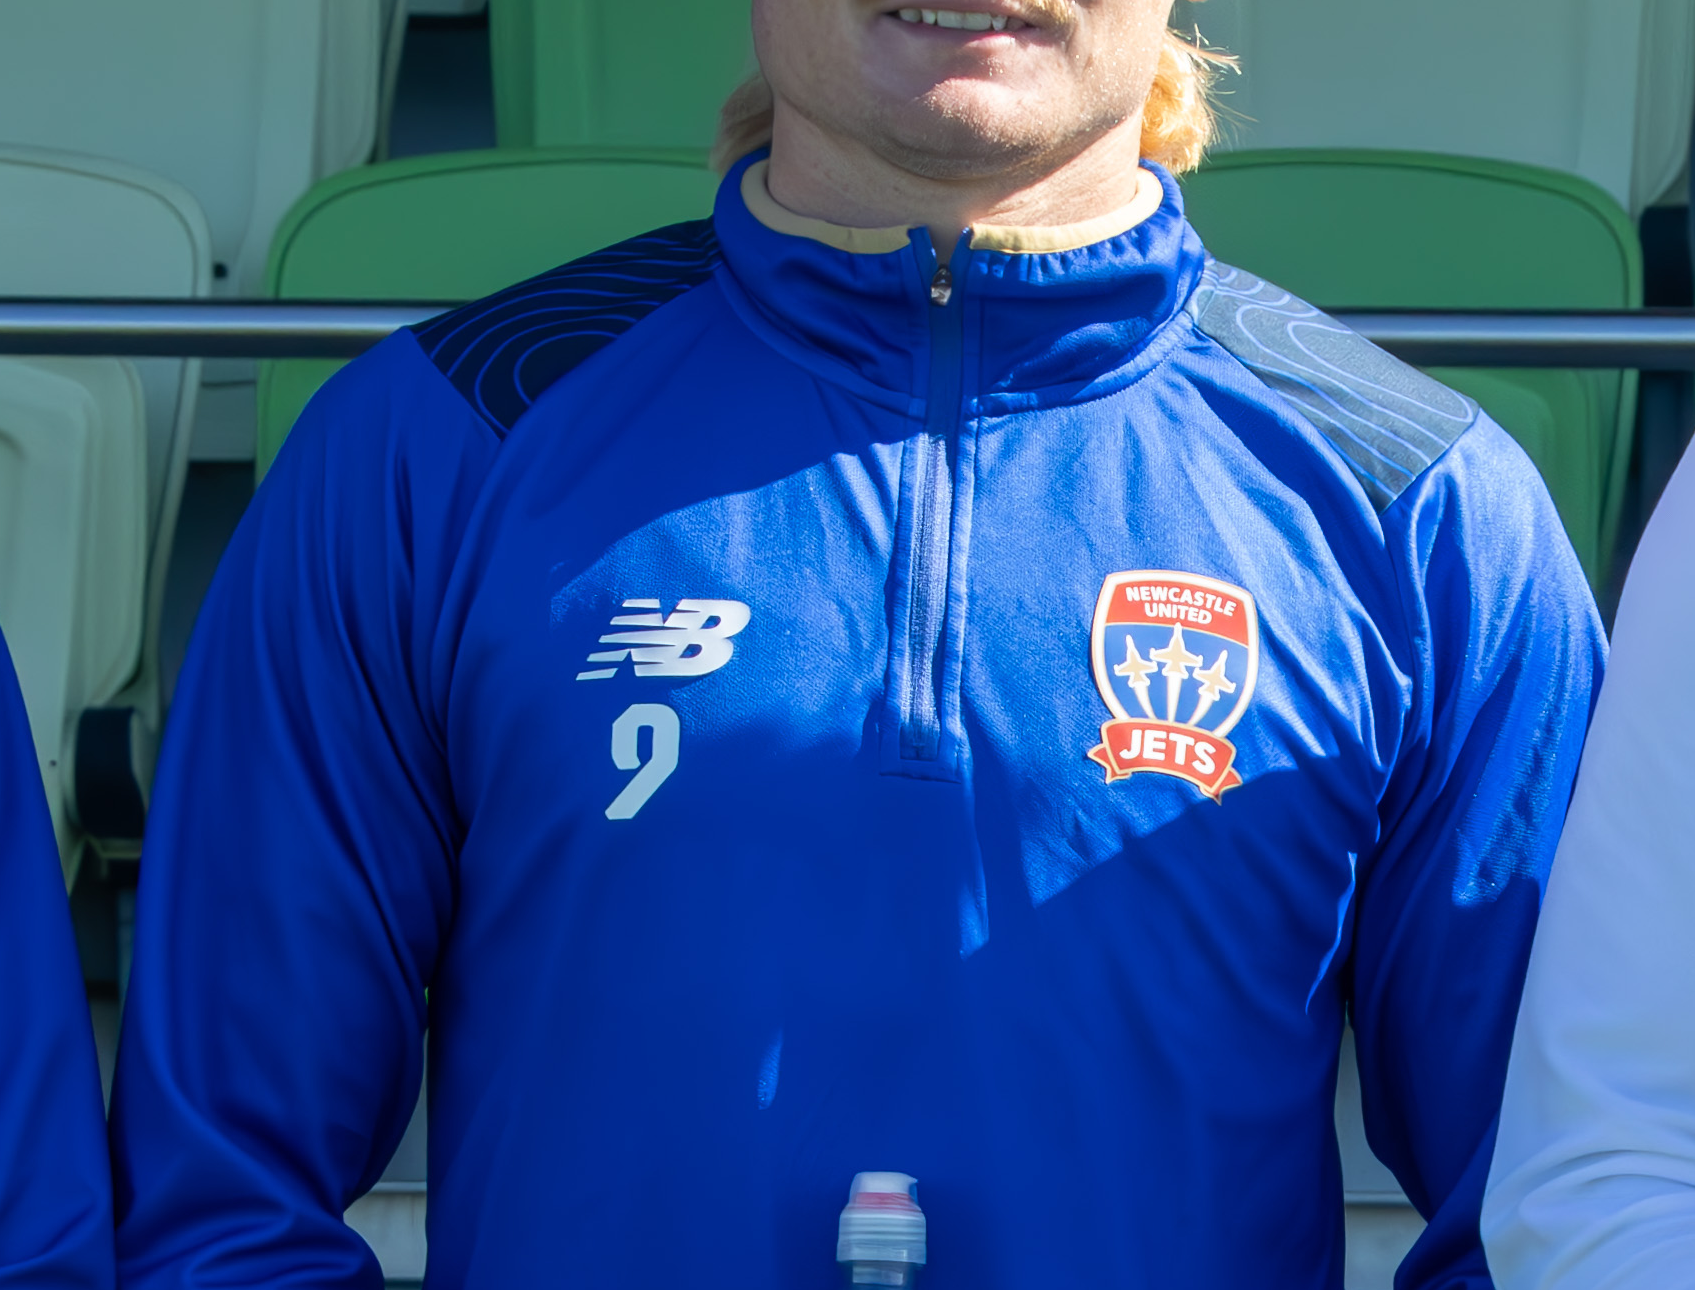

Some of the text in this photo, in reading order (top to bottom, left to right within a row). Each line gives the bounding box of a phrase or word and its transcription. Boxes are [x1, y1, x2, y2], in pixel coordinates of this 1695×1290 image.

[1125, 586, 1237, 617] NEWCASTLE
[1144, 602, 1213, 625] UNITED
[604, 703, 681, 821] 9
[1119, 728, 1216, 775] JETS
